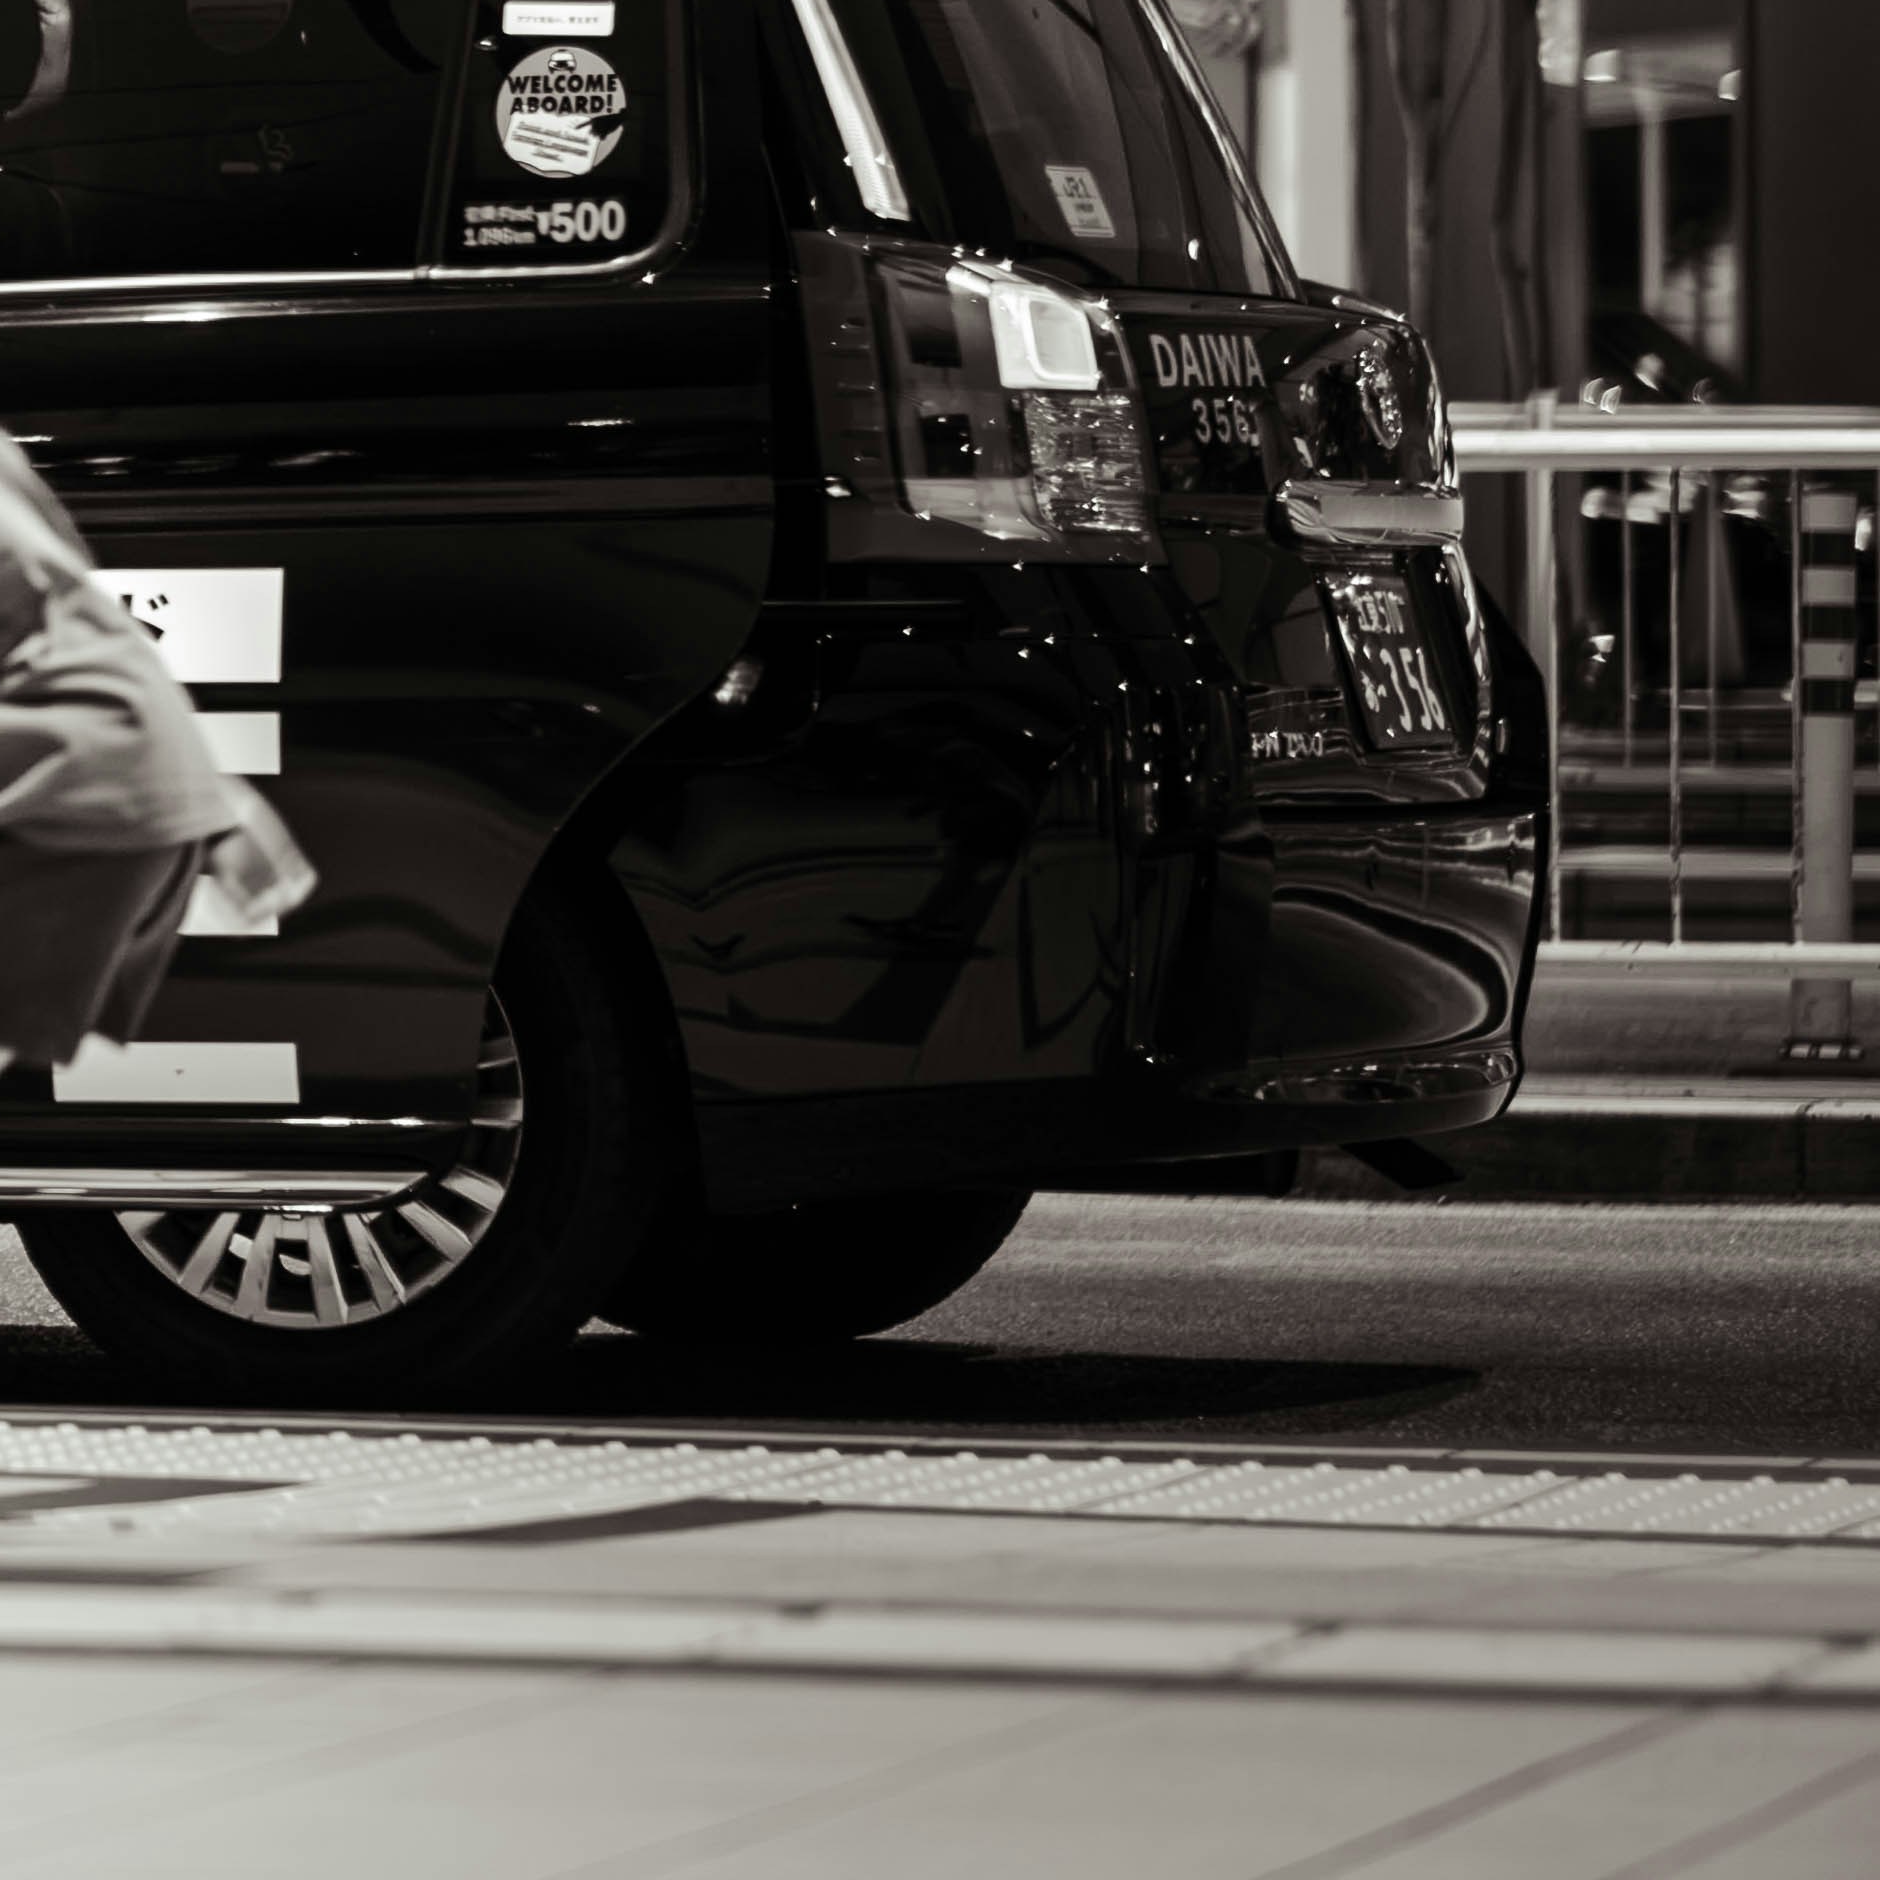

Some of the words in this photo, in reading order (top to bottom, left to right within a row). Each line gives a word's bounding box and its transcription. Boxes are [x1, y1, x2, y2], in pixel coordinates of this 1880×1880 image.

[507, 74, 617, 94] WELCOME
[510, 93, 613, 115] ABOARD!
[1149, 333, 1266, 388] DAIWA
[1192, 397, 1249, 443] 356
